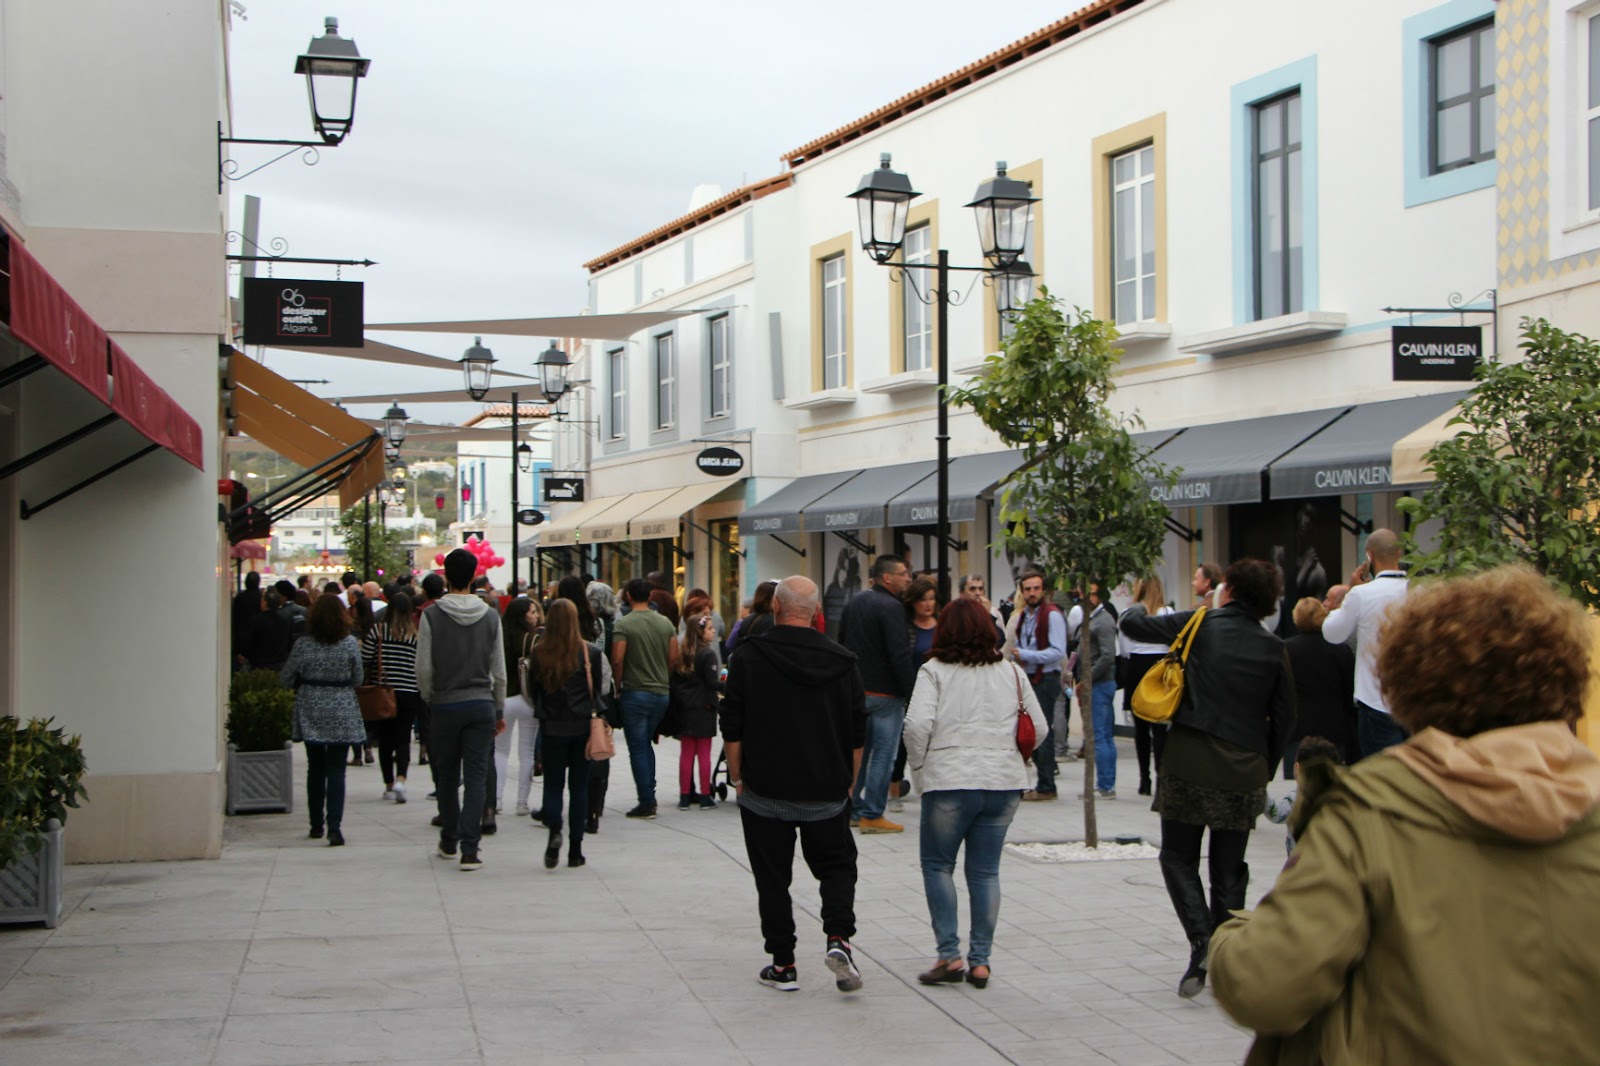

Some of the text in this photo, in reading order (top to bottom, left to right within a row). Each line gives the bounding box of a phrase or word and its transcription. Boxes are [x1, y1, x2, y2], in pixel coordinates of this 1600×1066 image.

[281, 306, 327, 316] designer
[281, 315, 314, 324] outlet
[281, 324, 318, 333] Algarve
[1398, 343, 1477, 357] CALVIN KLEIN
[699, 457, 741, 467] GARCIA JEANS
[1314, 466, 1391, 488] CALVIN KLEIN
[1184, 482, 1211, 499] KLEIN
